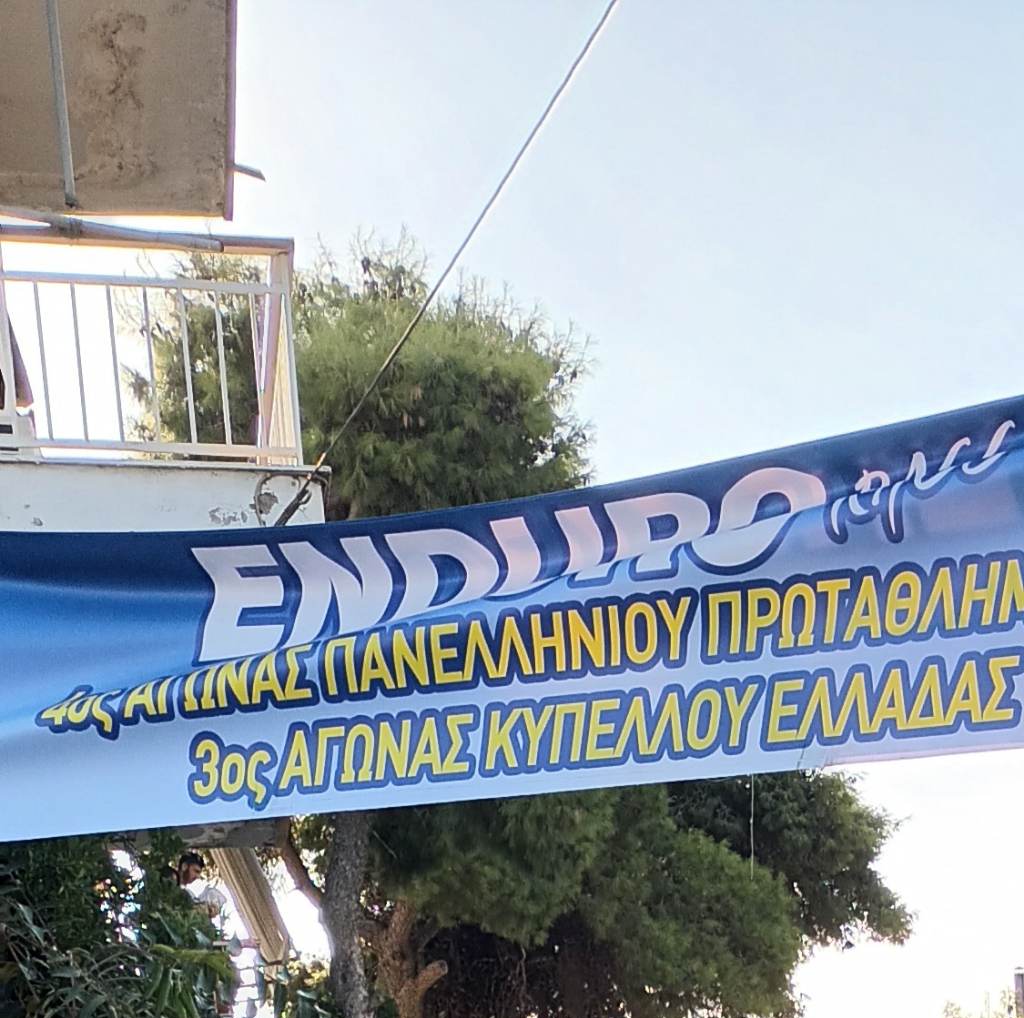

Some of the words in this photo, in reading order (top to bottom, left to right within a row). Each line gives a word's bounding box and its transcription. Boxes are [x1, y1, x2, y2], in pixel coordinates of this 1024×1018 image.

[324, 597, 691, 695] ΠΑΝΕΛΛΗΝΙΟΥ
[193, 739, 271, 804] 3ος
[279, 713, 474, 790] ΑΓΩΝΑΣ
[485, 685, 756, 770] ΚΥΠΕΛΛΟΥ
[767, 655, 1021, 744] ΕΛΛΑΔΑΣ
